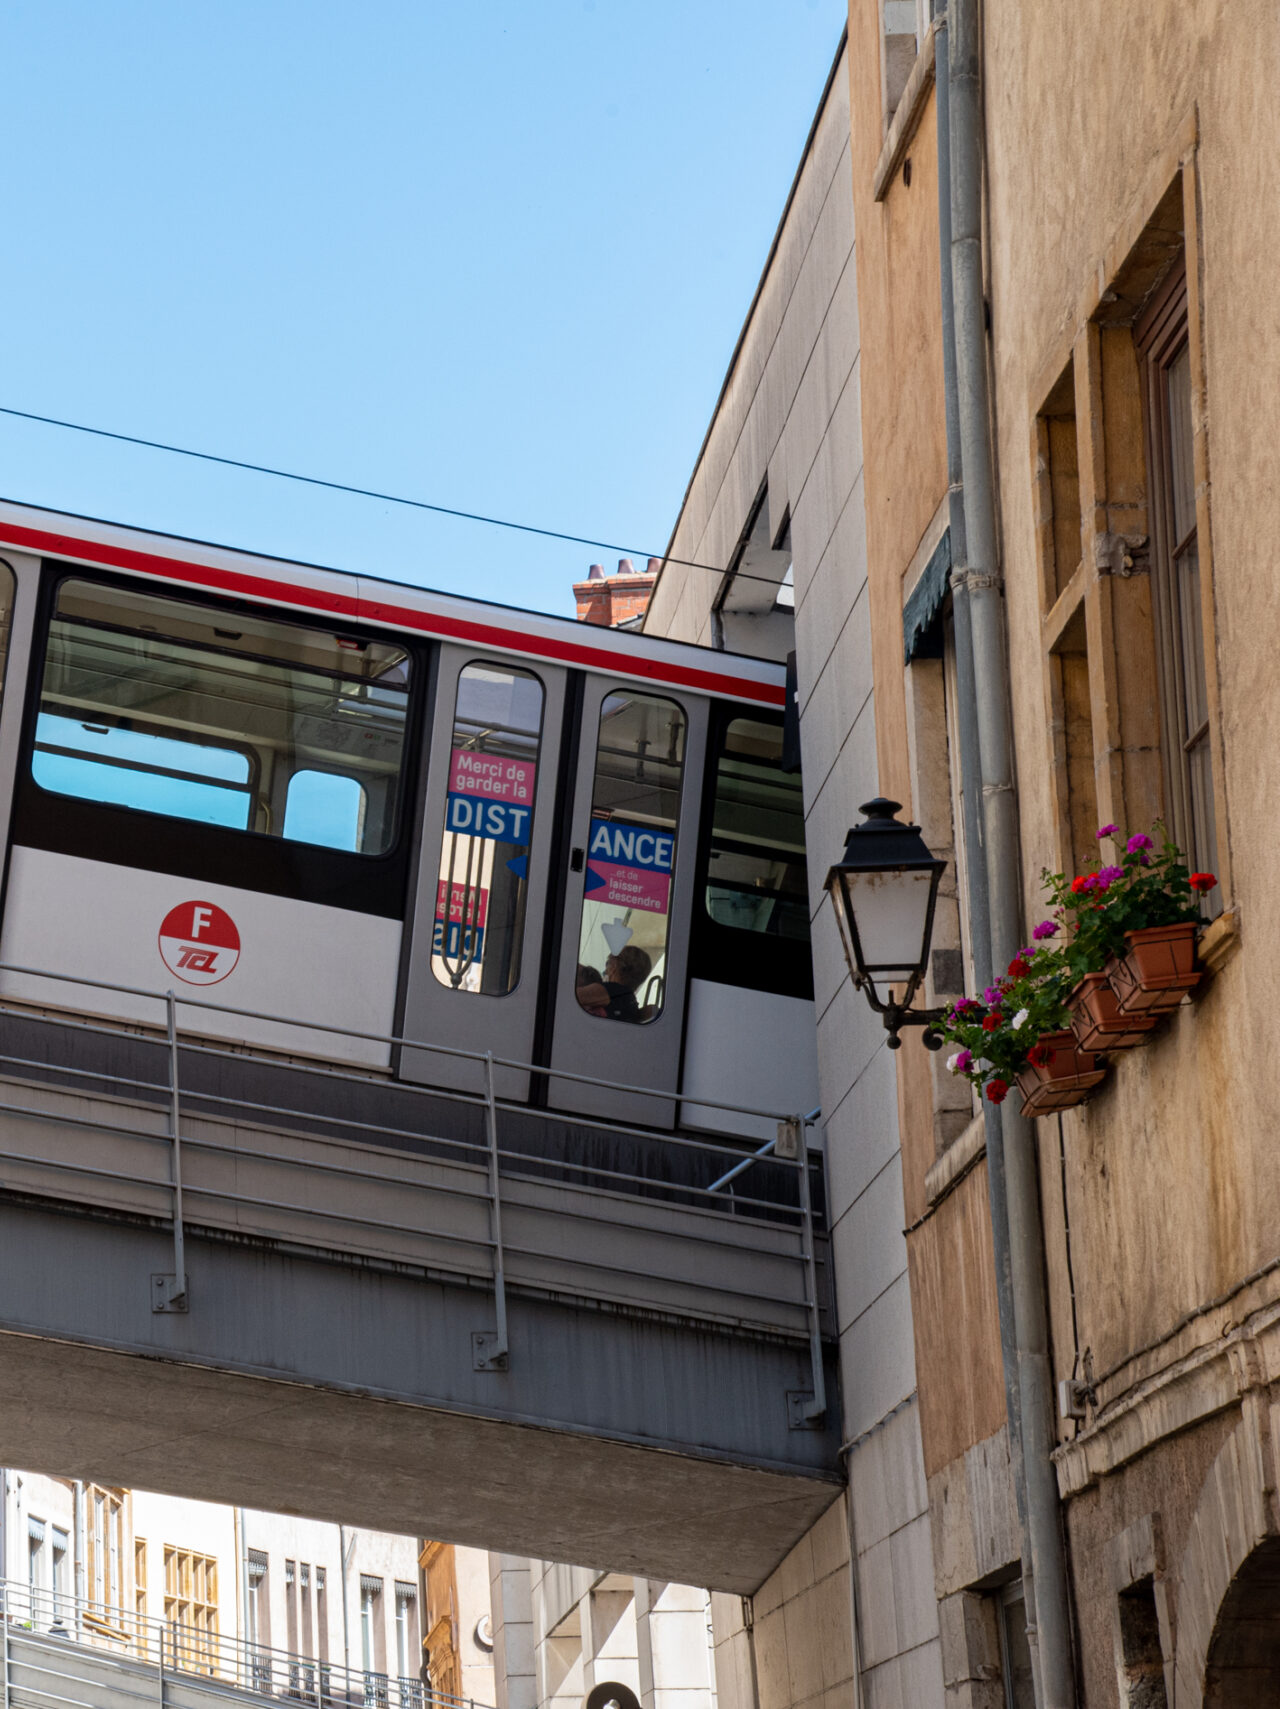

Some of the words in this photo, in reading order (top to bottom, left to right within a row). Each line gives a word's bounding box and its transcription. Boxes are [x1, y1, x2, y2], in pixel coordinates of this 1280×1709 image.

[457, 755, 502, 777] Merci
[506, 765, 525, 781] de
[456, 774, 509, 794] garder
[513, 781, 527, 798] la
[452, 798, 528, 838] DIST
[590, 826, 672, 867] ANCE
[609, 878, 644, 893] laisser
[627, 870, 638, 880] de
[608, 890, 661, 909] descendre
[191, 906, 213, 938] F
